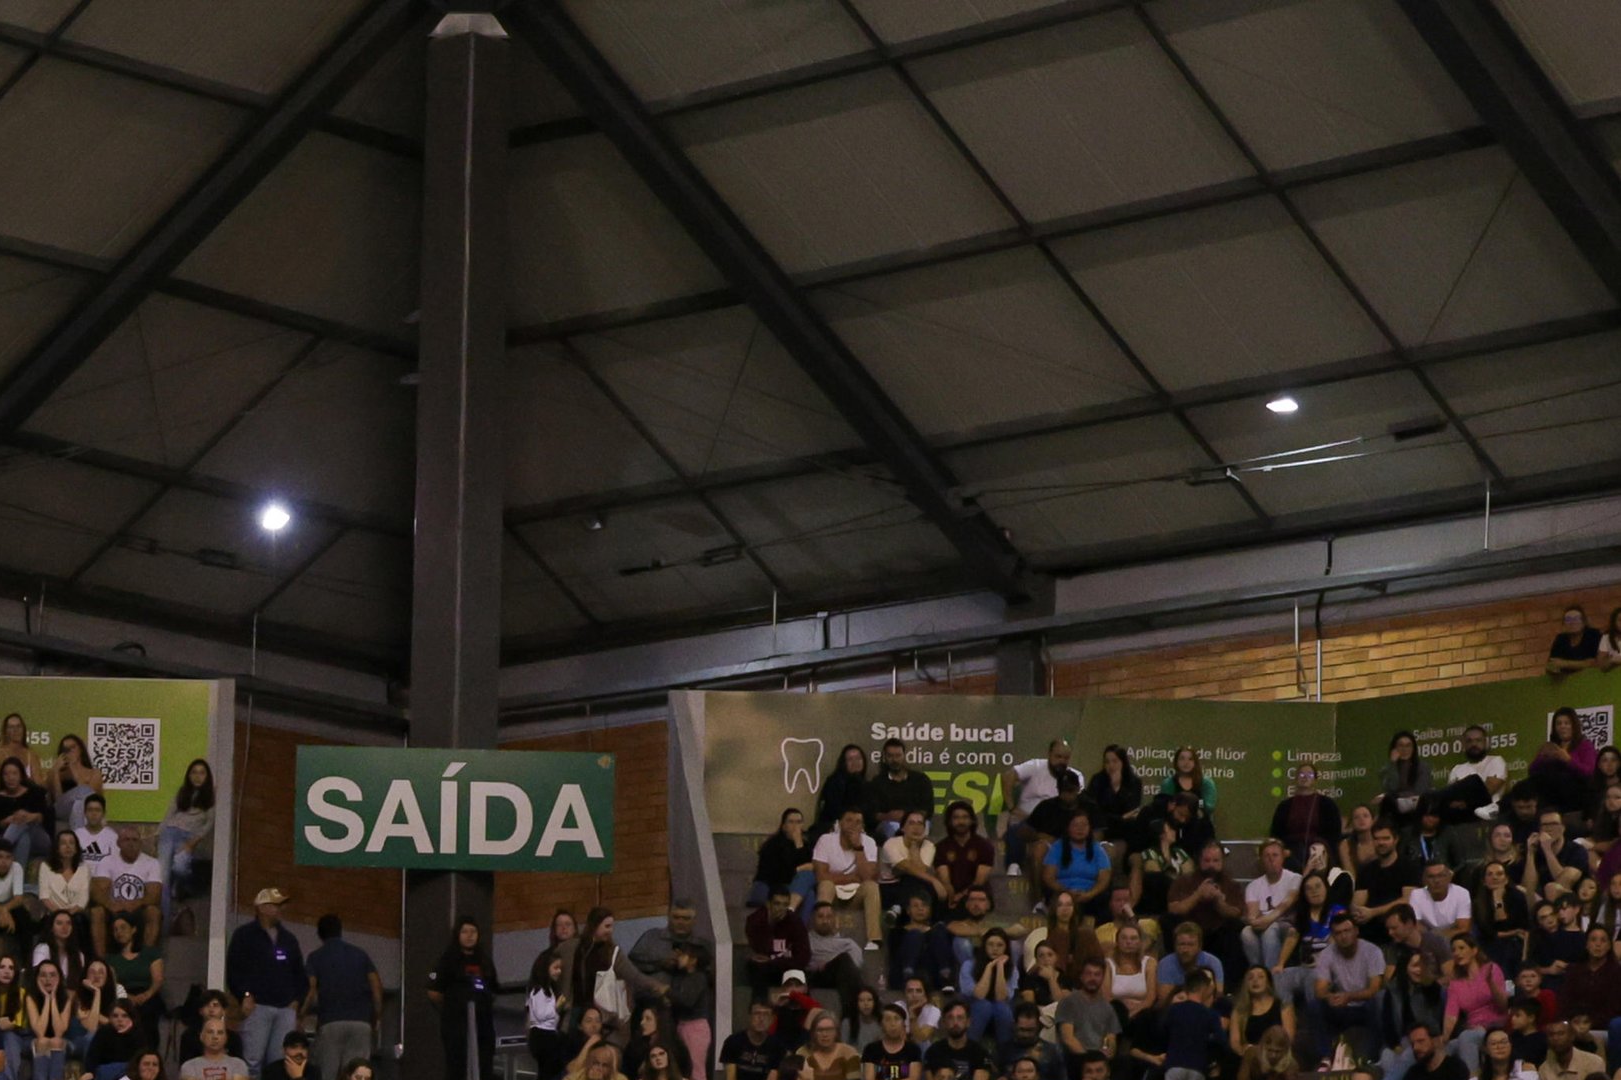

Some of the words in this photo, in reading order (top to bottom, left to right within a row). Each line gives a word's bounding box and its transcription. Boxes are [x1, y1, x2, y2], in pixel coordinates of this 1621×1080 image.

[871, 722, 944, 742] Saúde
[950, 723, 1014, 743] bucal
[1413, 728, 1444, 741] Saiba
[1486, 733, 1518, 751] 555
[106, 747, 143, 761] SESI
[906, 747, 933, 764] dia
[939, 747, 950, 765] é
[956, 752, 996, 765] com
[1002, 753, 1014, 765] o
[1126, 746, 1175, 763] Aplicaç
[1196, 748, 1212, 760] de
[1215, 746, 1247, 761] flúor
[1287, 750, 1342, 764] Limpeza
[924, 771, 1004, 816] ESI
[303, 762, 606, 859] SAÍDA
